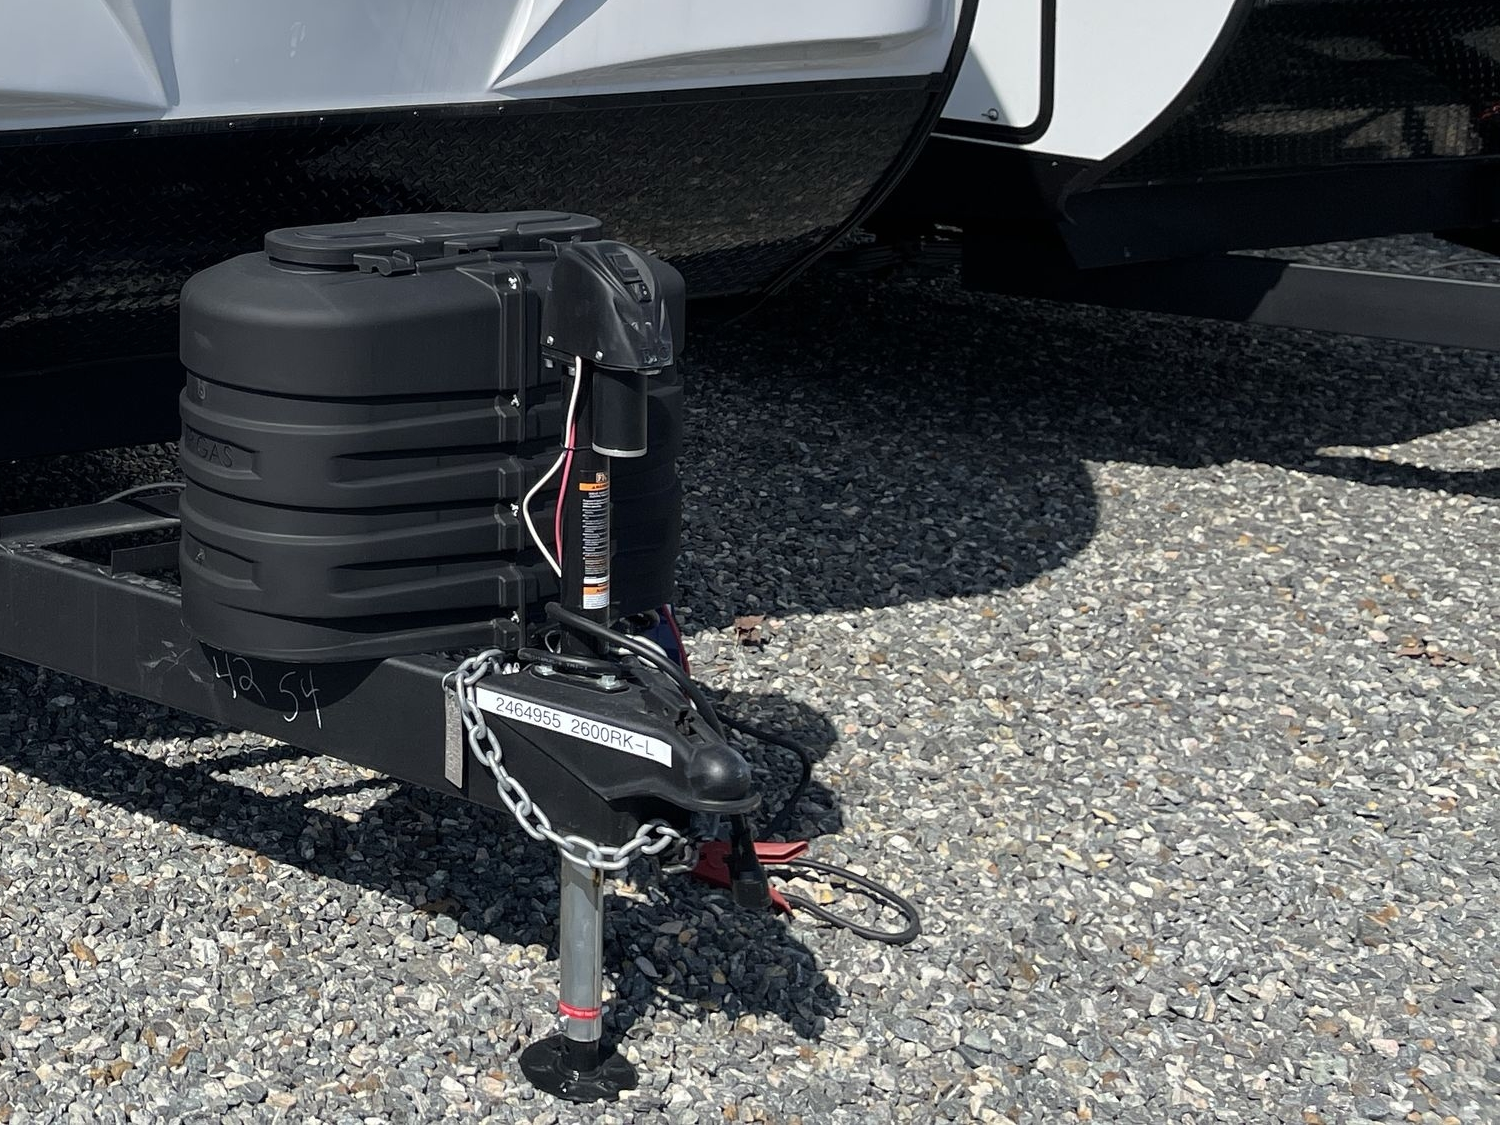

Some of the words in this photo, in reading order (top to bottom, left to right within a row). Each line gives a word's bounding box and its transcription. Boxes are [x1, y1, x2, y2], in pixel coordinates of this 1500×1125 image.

[213, 653, 267, 704] 42
[279, 670, 321, 729] 54
[495, 697, 561, 728] 2464955
[570, 718, 655, 757] 2600RK-L
